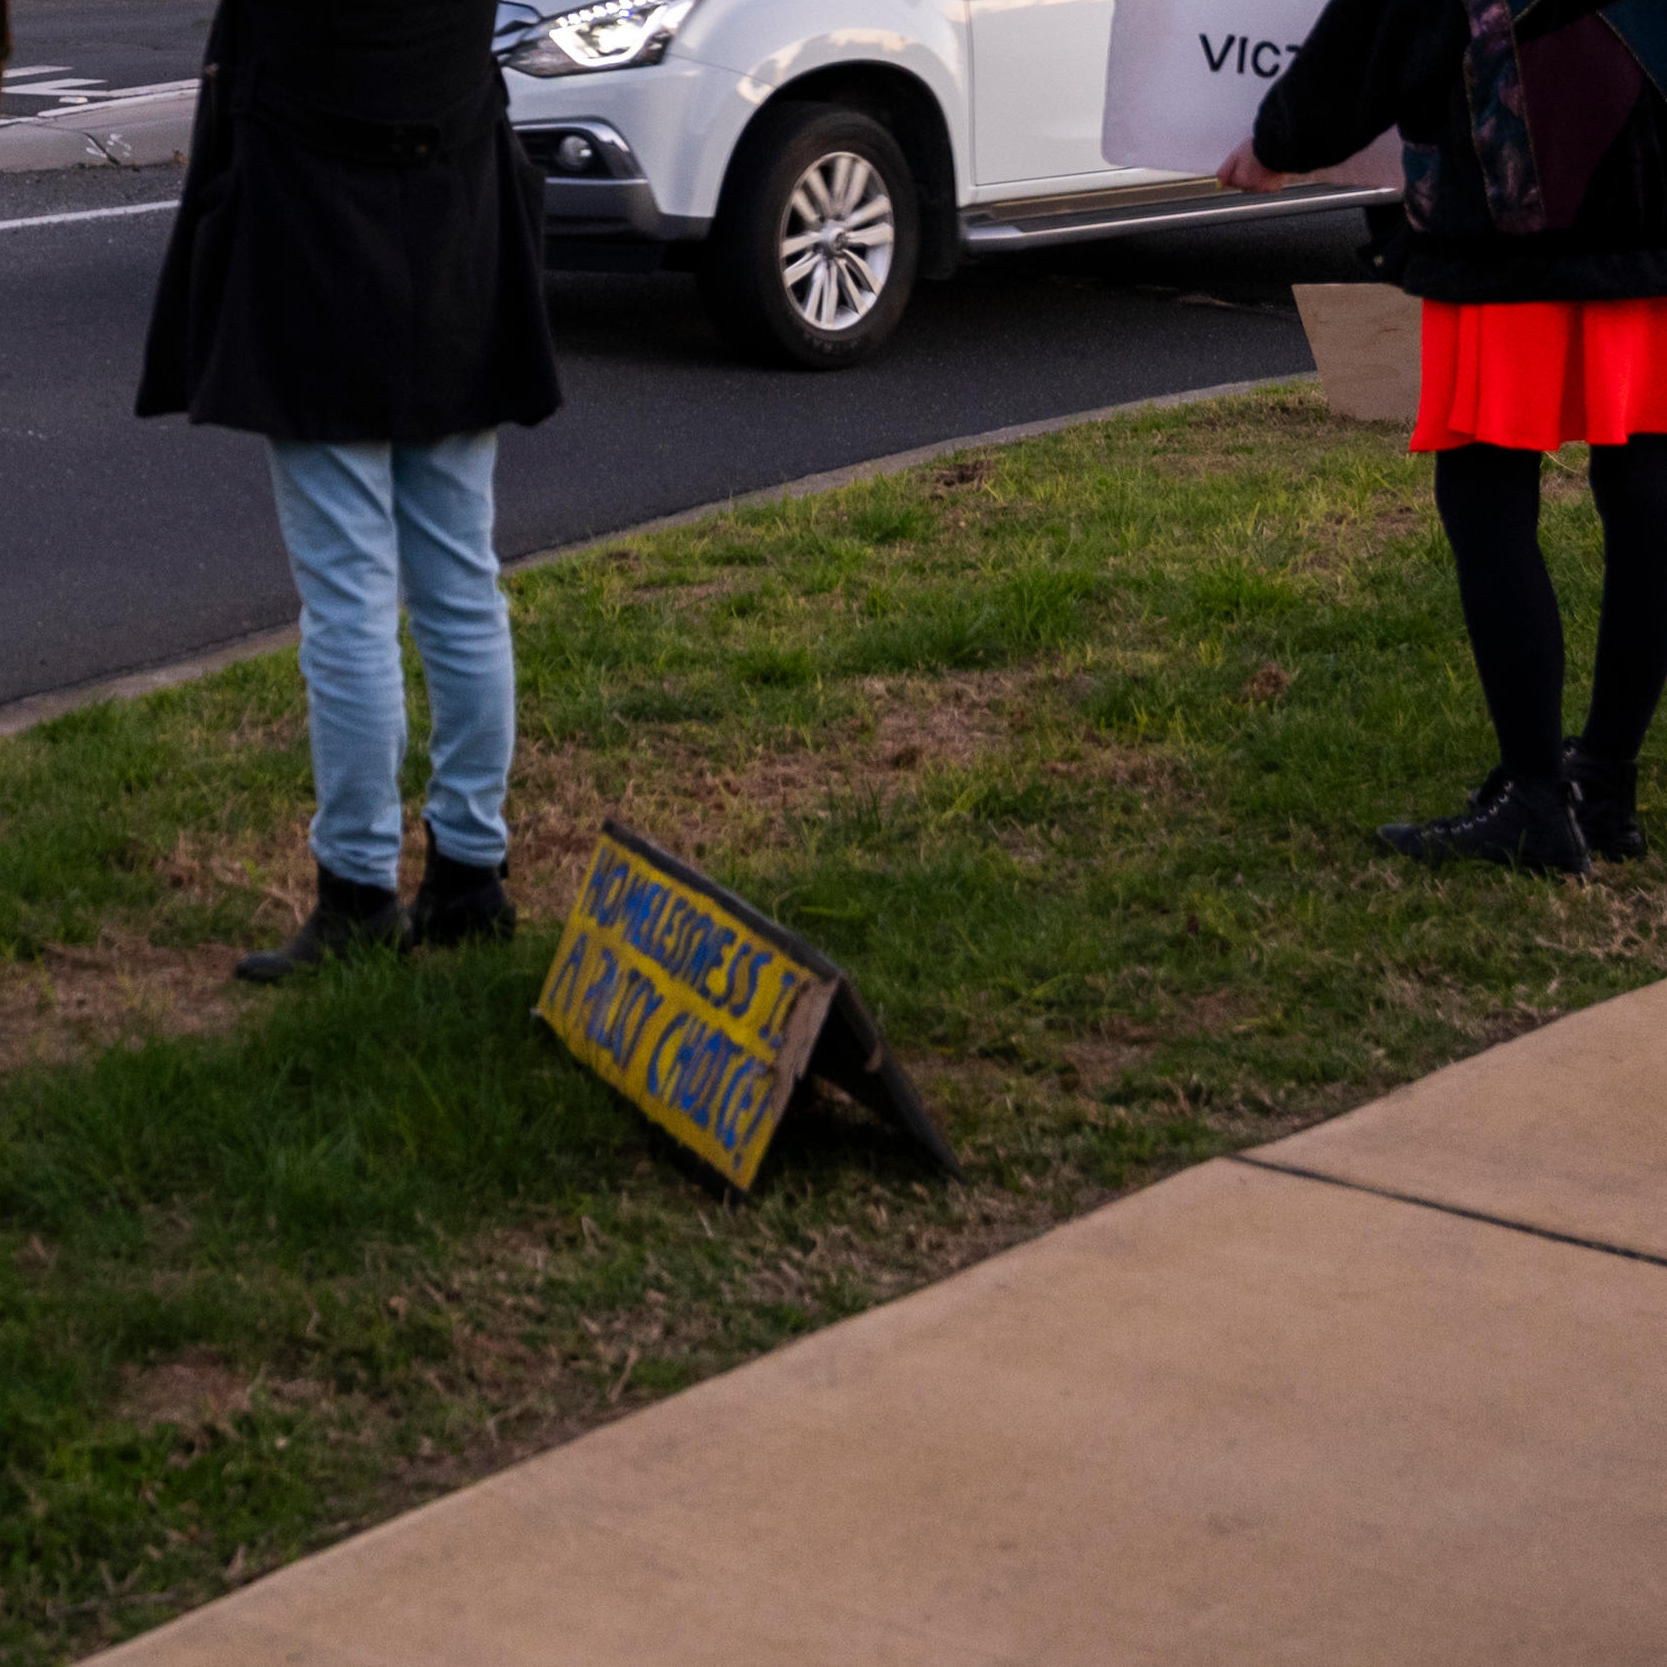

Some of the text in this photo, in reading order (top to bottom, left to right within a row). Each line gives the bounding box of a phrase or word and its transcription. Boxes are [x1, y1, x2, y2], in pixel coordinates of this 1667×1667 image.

[1198, 33, 1302, 79] VIC
[547, 931, 589, 1016] A
[578, 845, 773, 1019] HOMELESSNESS
